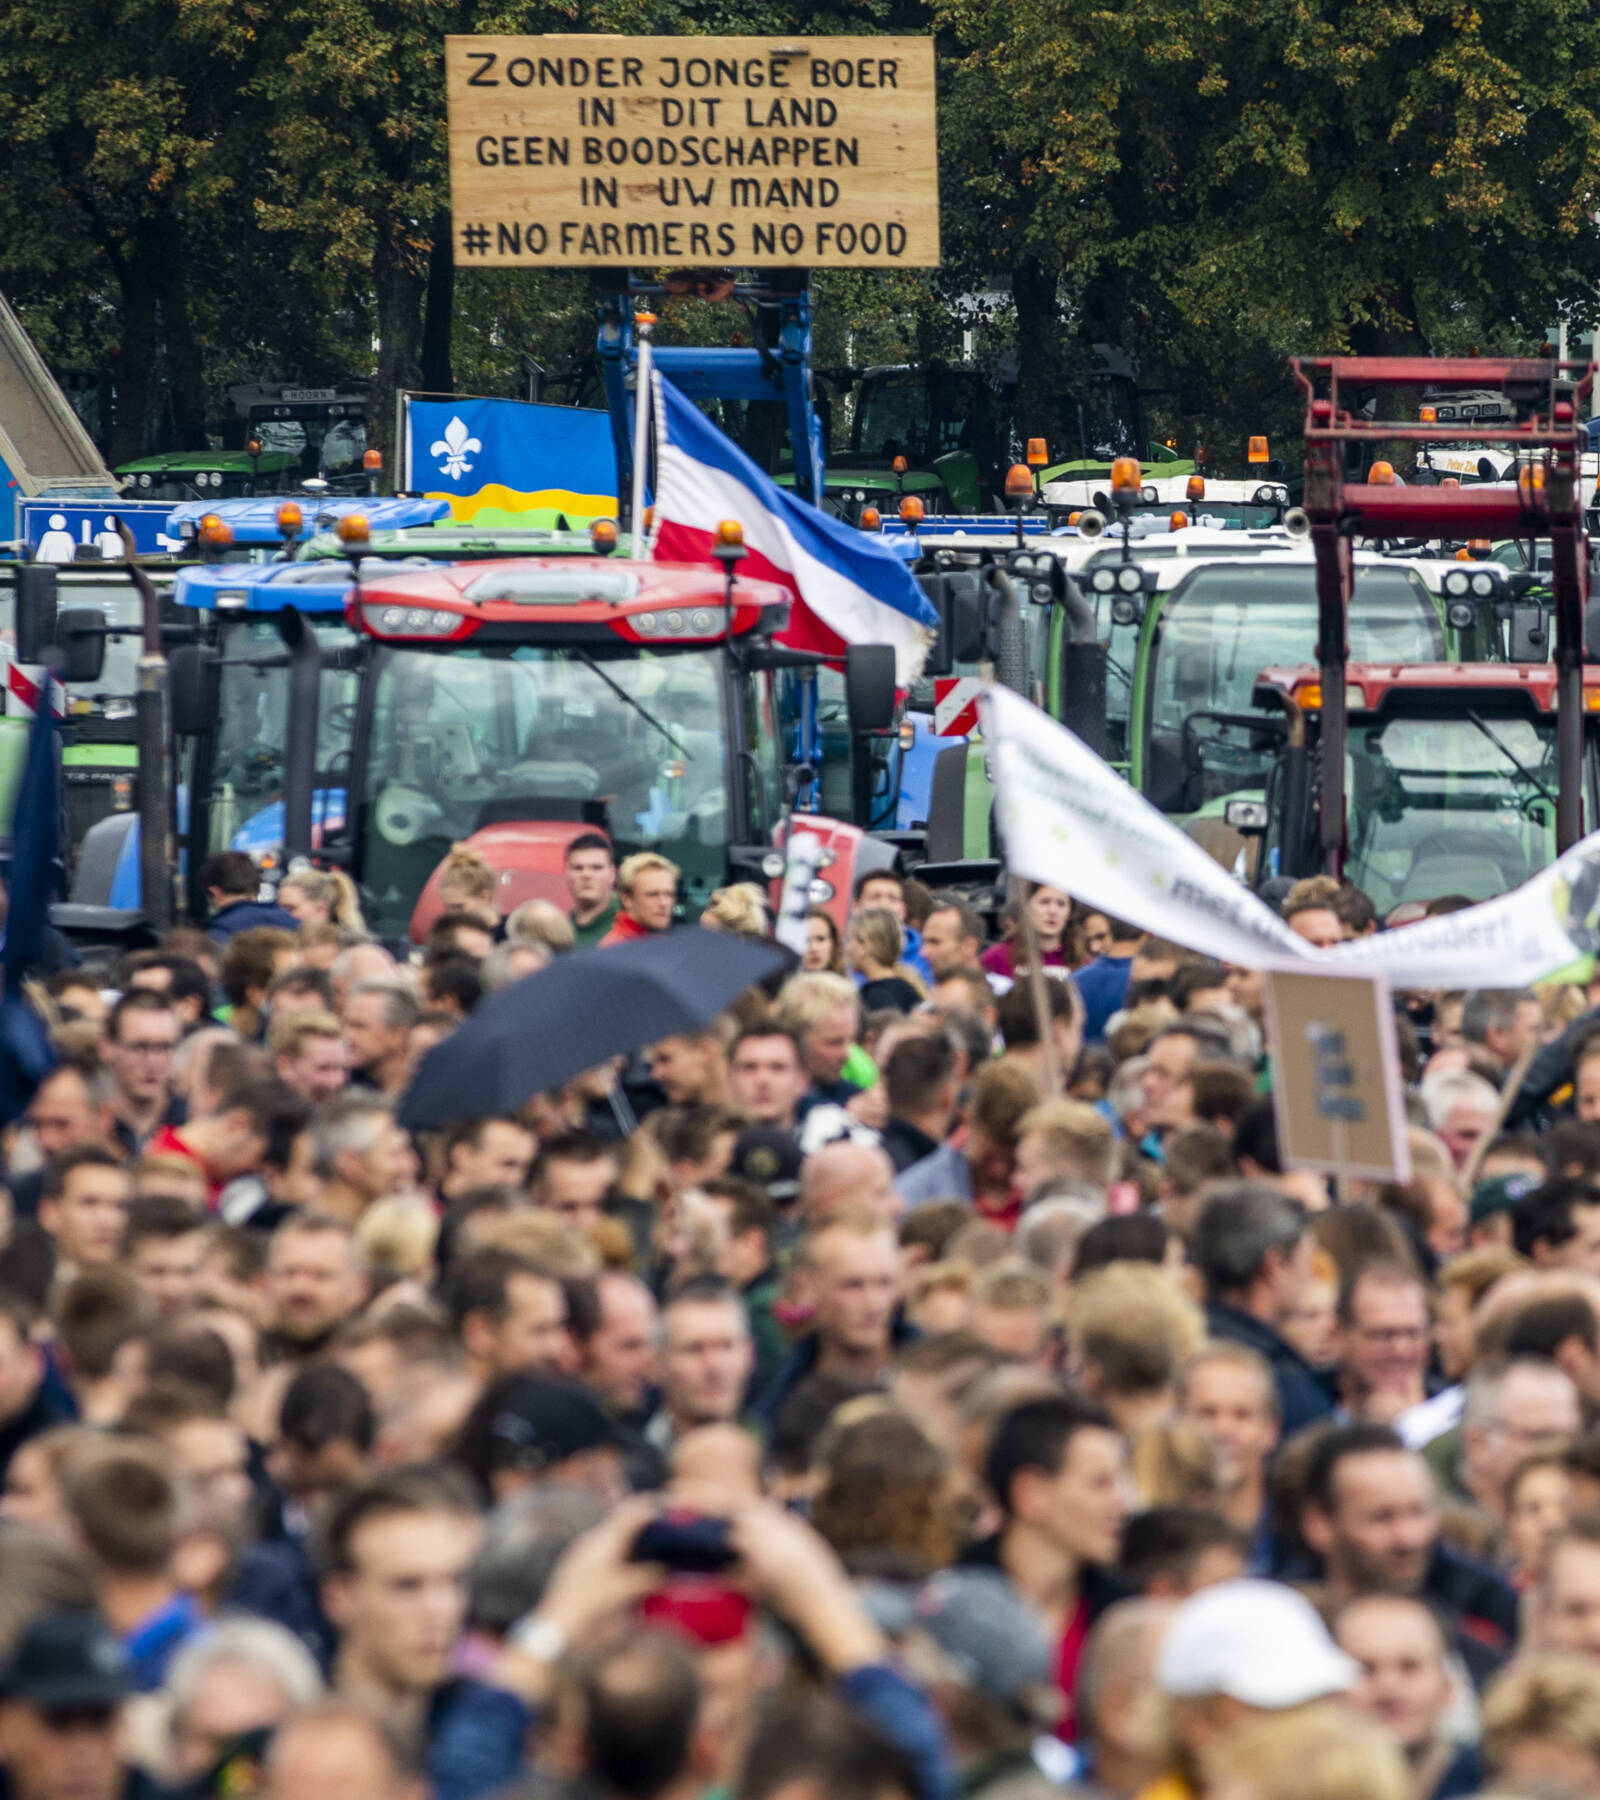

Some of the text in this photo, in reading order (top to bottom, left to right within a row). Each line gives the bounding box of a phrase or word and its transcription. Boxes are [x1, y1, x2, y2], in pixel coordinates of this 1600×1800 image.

[467, 53, 898, 88] ZONDER JONGE BOER
[579, 97, 838, 128] IN DIT LAND
[476, 136, 859, 167] GEEN BOODSCHAPPEN
[581, 177, 618, 208] IN
[658, 178, 714, 207] UW
[461, 222, 547, 256] #NO
[752, 223, 804, 256] NO
[816, 222, 907, 257] FOOD
